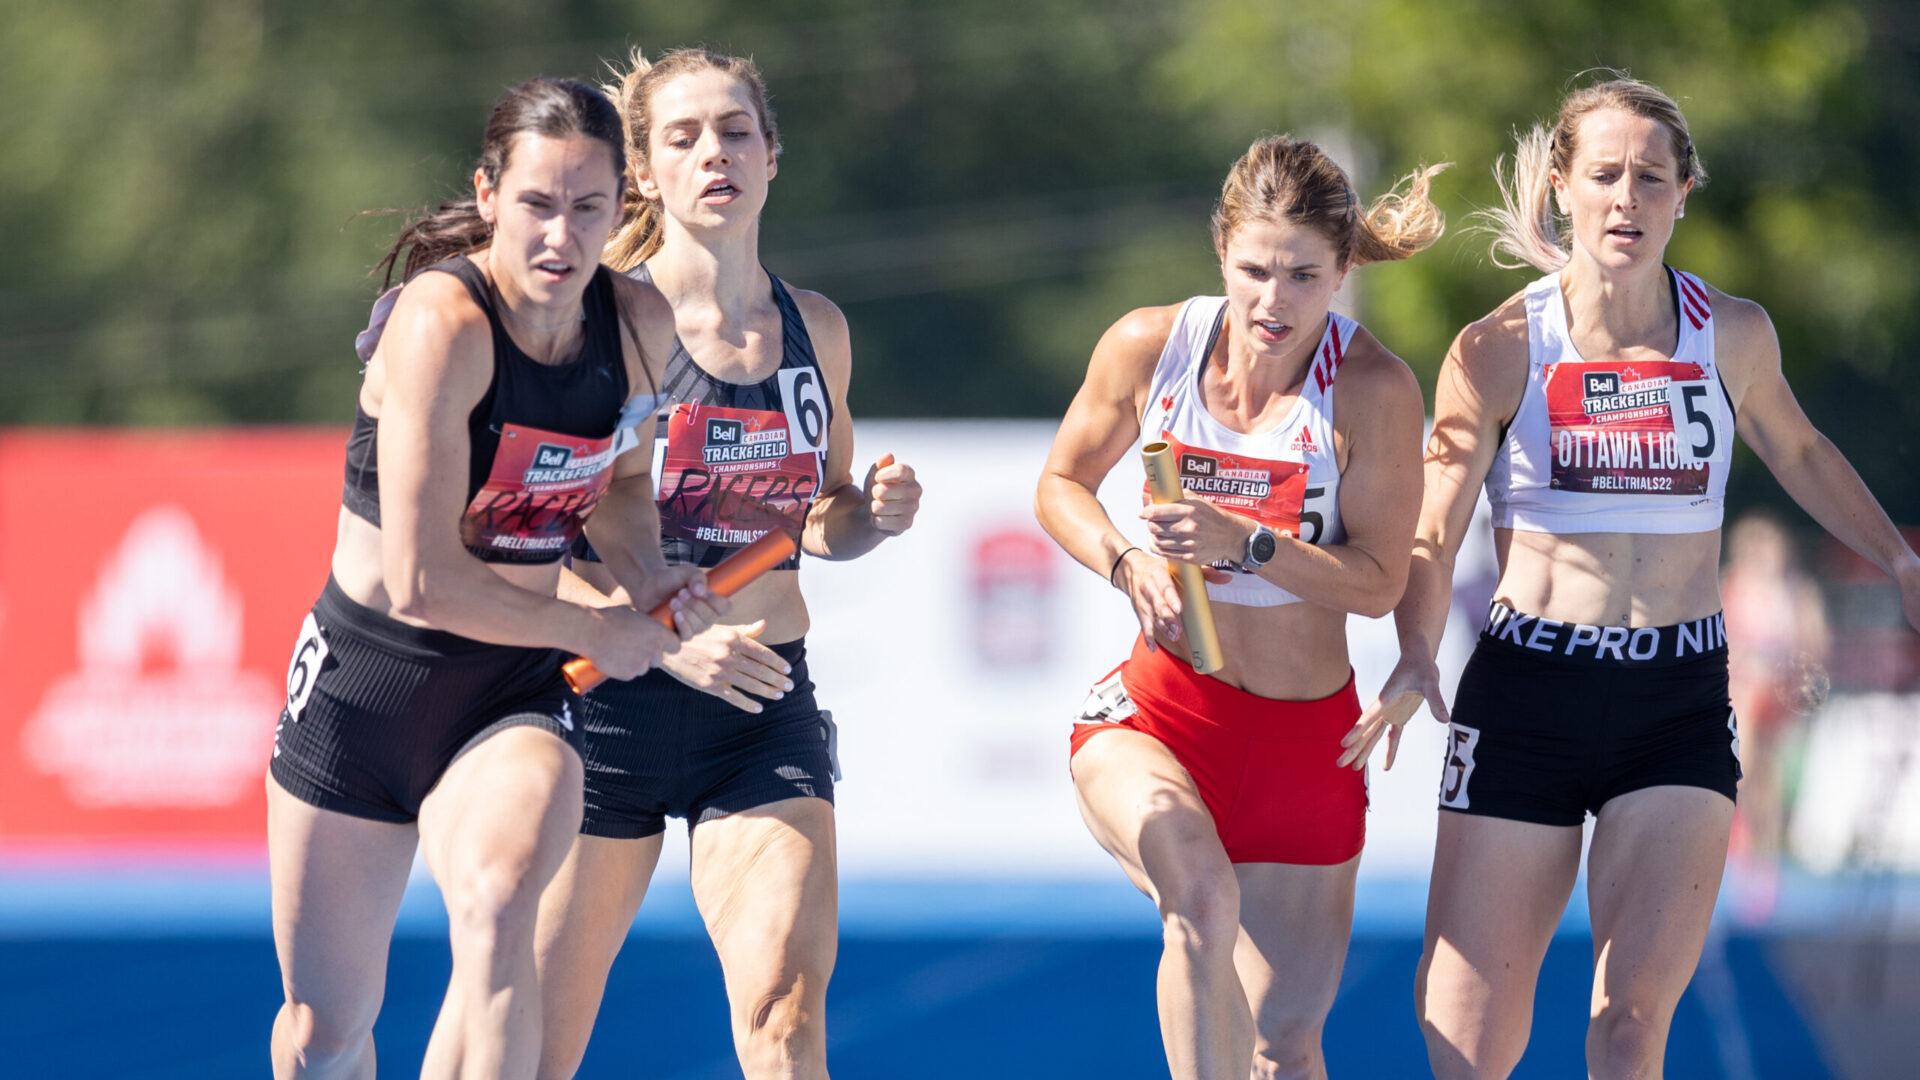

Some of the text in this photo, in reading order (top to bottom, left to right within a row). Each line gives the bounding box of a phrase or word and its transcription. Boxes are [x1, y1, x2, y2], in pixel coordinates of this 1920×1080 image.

[1590, 378, 1613, 392] Bell
[1622, 378, 1669, 393] CANADIAN
[794, 372, 823, 447] 6
[1596, 407, 1663, 423] CHAMPIONSHIPS
[1682, 385, 1715, 458] 5
[713, 426, 735, 441] Bell
[743, 431, 784, 443] CANADIAN
[704, 443, 787, 463] TRACK&FIELD
[1290, 441, 1317, 453] addas
[1558, 430, 1705, 471] OTTAWA LIO
[539, 450, 565, 466] Bell
[1187, 459, 1210, 473] Bell
[713, 461, 776, 474] CHAMPIONSHIPS
[1218, 470, 1267, 480] CANADIAN
[1180, 476, 1268, 497] TRACK&FIELD
[1592, 476, 1672, 490] #BELLTRIALS22
[661, 469, 812, 521] RACERS
[1200, 494, 1254, 507] MPIONSHIPS
[1299, 487, 1325, 545] 5
[491, 535, 565, 549] #BELLTRIALS22
[1564, 624, 1660, 660] PRO
[1192, 651, 1204, 669] 5
[289, 637, 319, 703] 6
[1444, 730, 1470, 803] 5
